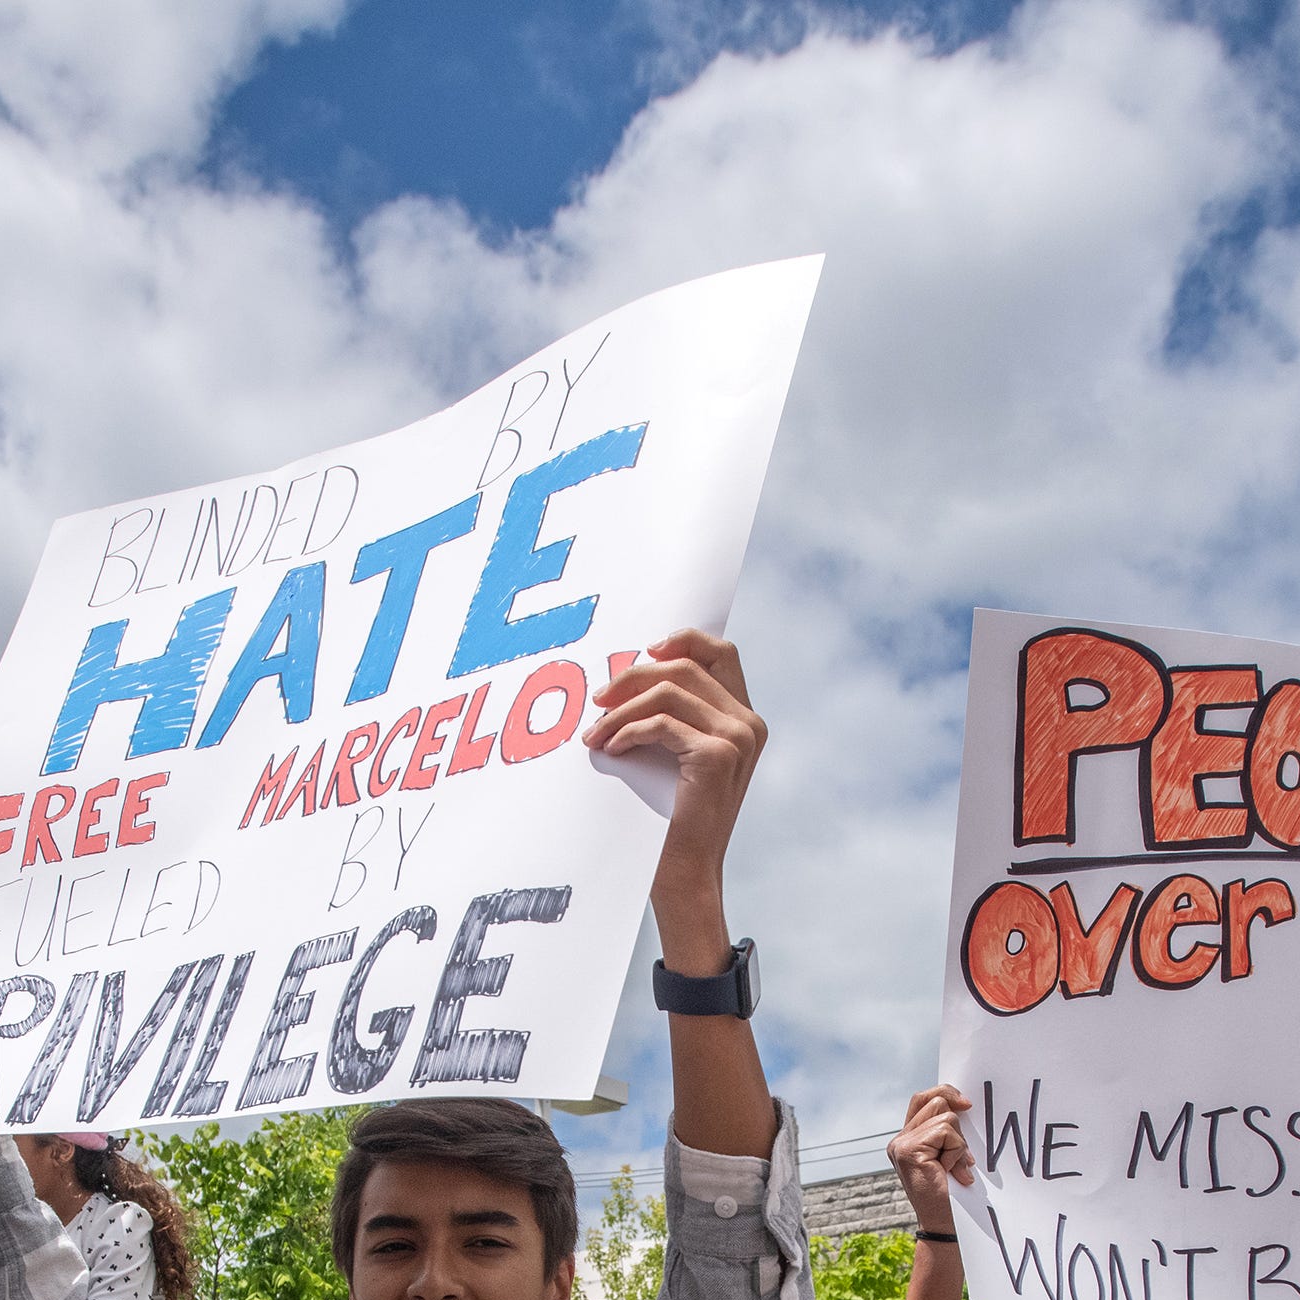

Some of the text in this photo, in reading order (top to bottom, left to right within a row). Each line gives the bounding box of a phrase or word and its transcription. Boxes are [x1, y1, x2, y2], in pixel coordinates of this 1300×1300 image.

[87, 330, 612, 607] BLINDED BY
[39, 419, 650, 777] HATE
[237, 650, 641, 831] MARCELO
[327, 801, 436, 911] BY
[983, 1077, 1085, 1181] WE
